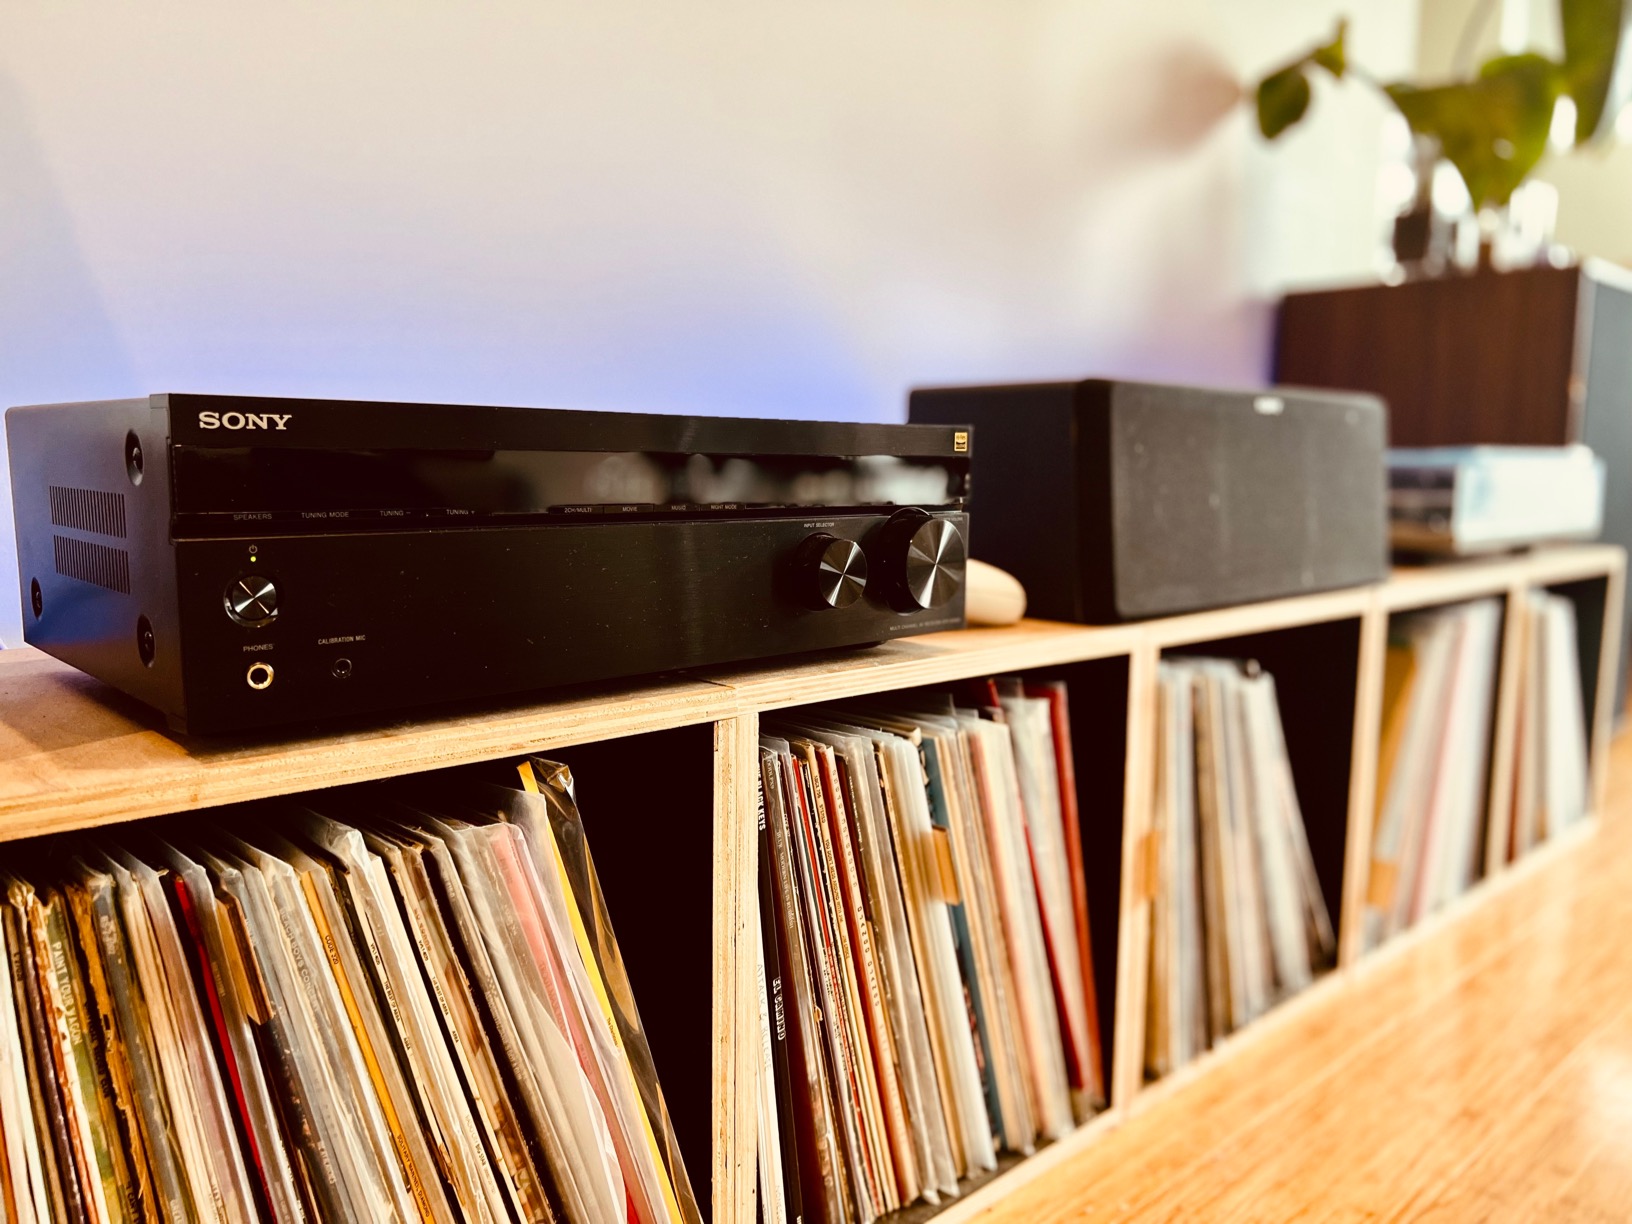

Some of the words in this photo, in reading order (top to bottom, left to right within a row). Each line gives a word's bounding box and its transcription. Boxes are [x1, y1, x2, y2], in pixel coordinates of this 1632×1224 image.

[199, 411, 292, 430] SONY
[243, 644, 274, 652] PHONES
[318, 636, 354, 645] CALIBRATION
[278, 906, 294, 940] BEACH
[291, 941, 303, 968] BOYS
[324, 934, 334, 953] CODE
[51, 940, 66, 975] PAINT
[59, 975, 73, 1006] YOUR
[772, 976, 781, 994] EL
[756, 963, 765, 1004] ATTACK
[761, 1026, 771, 1072] RELEASE
[774, 994, 786, 1040] CAMINO
[417, 1191, 430, 1217] DIAMOND
